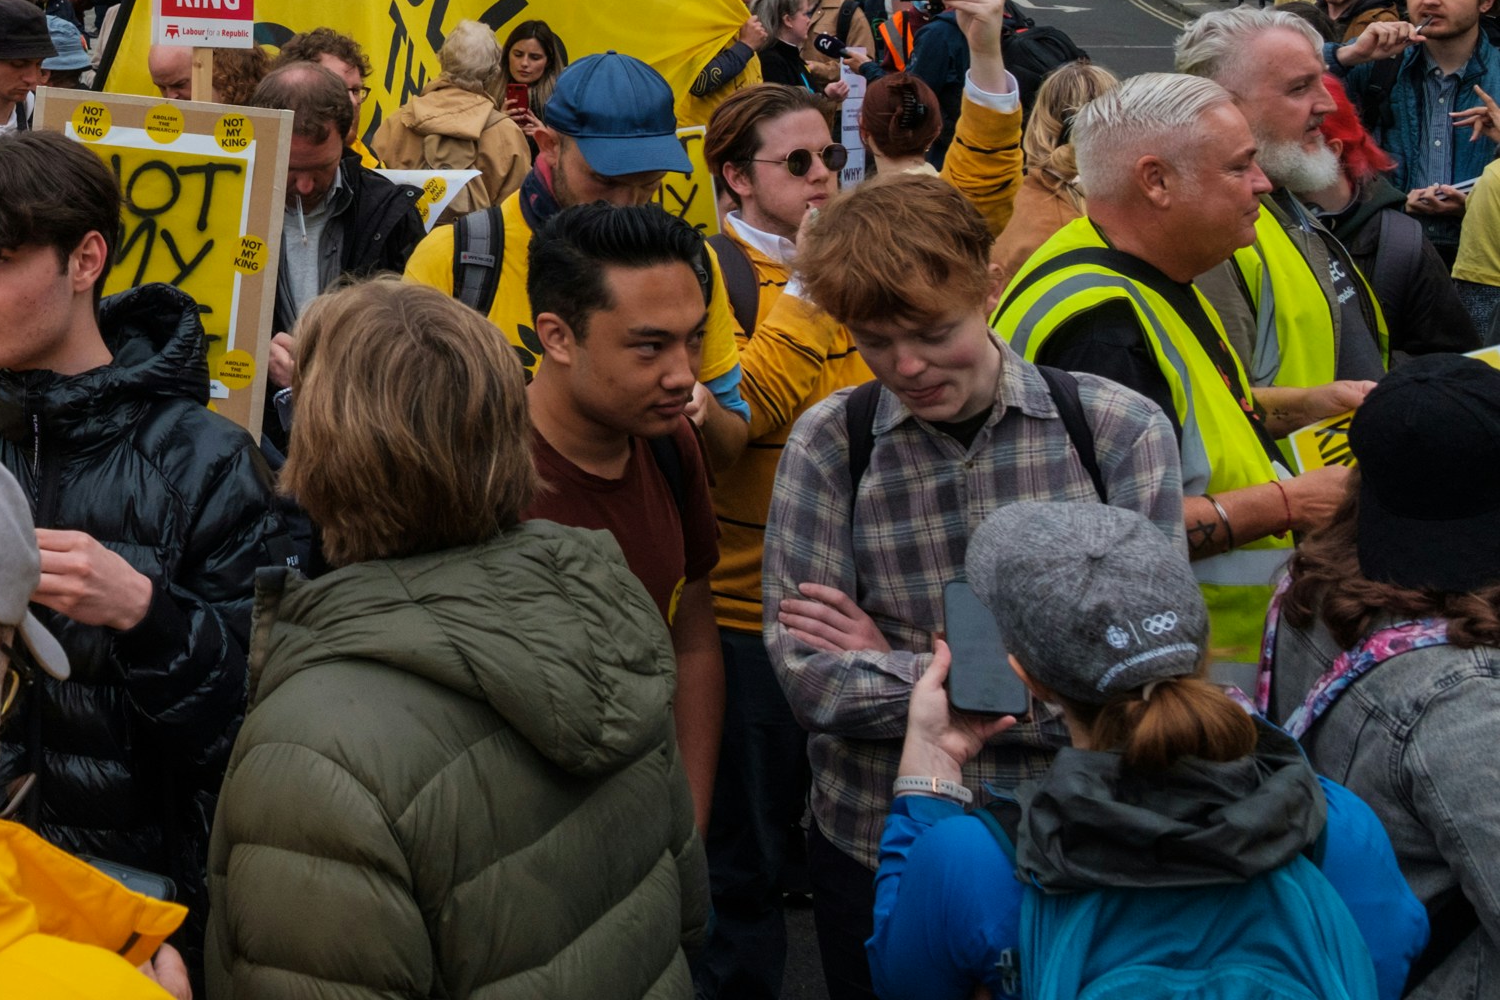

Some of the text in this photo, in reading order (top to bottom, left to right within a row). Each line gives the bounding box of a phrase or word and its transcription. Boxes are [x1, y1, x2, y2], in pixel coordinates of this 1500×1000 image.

[182, 27, 205, 36] Labour
[206, 28, 215, 36] for
[221, 28, 249, 39] Republic
[82, 106, 104, 116] NOT
[83, 116, 100, 126] MY
[223, 118, 244, 127] NOT
[77, 125, 103, 137] KING
[147, 126, 179, 134] MONARCHY
[226, 128, 241, 137] MY
[221, 138, 247, 147] KING
[424, 179, 437, 192] NOT
[430, 185, 439, 195] MY
[111, 154, 242, 232] OT
[431, 186, 446, 202] KING
[241, 238, 262, 251] NOT
[241, 249, 257, 260] MY
[234, 257, 259, 271] KING
[220, 371, 251, 379] MONARCHY
